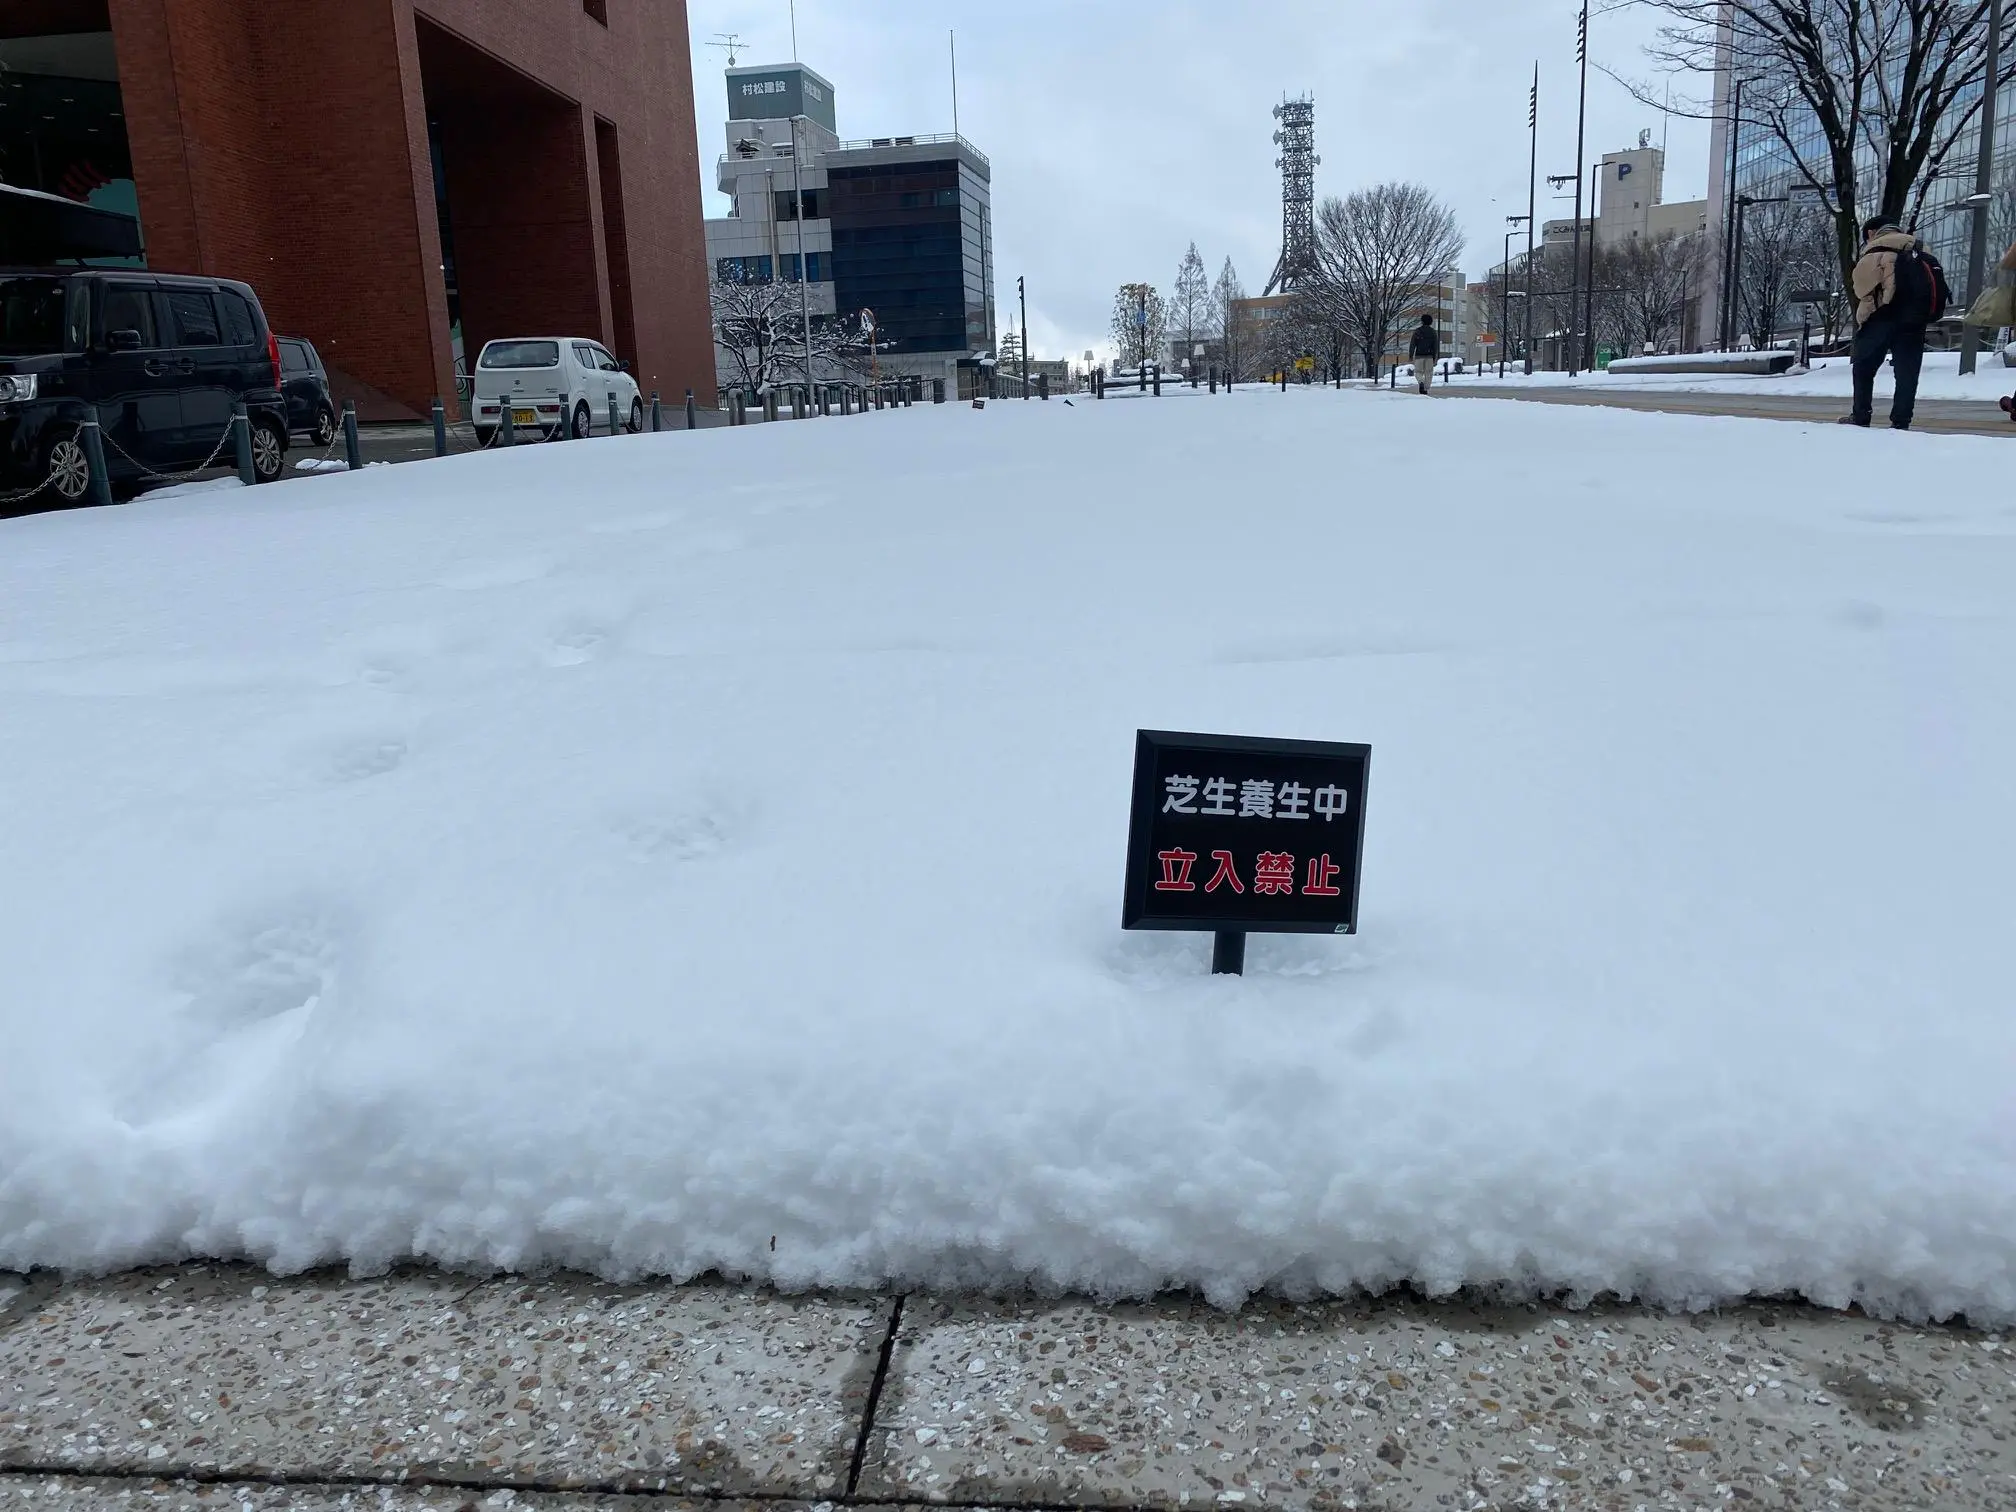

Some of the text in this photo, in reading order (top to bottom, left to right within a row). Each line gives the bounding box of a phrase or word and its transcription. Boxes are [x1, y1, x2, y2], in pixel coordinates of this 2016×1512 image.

[742, 80, 786, 96] 村松建設
[1618, 163, 1632, 181] P
[1162, 773, 1348, 822] 芝生養生中
[1155, 846, 1340, 896] 立入禁止
